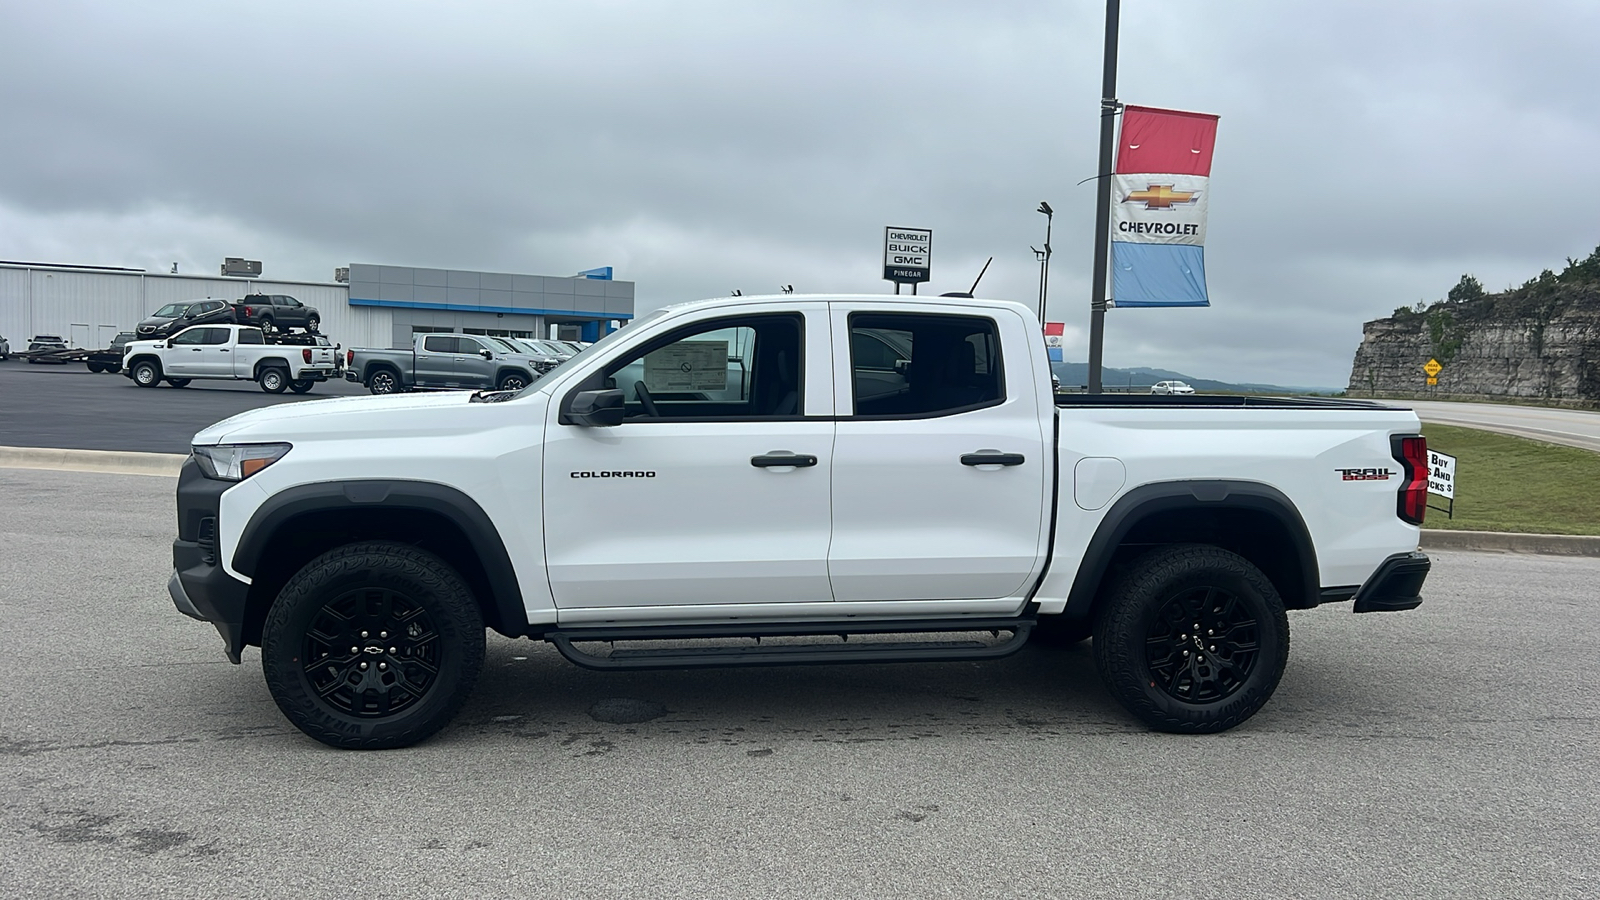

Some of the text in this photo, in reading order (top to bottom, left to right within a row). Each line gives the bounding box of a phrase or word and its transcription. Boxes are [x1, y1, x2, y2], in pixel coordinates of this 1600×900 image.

[1119, 221, 1199, 236] CHEVROLET
[890, 232, 928, 241] CHEVROLET
[889, 244, 927, 253] BUICK
[894, 256, 922, 264] GMC
